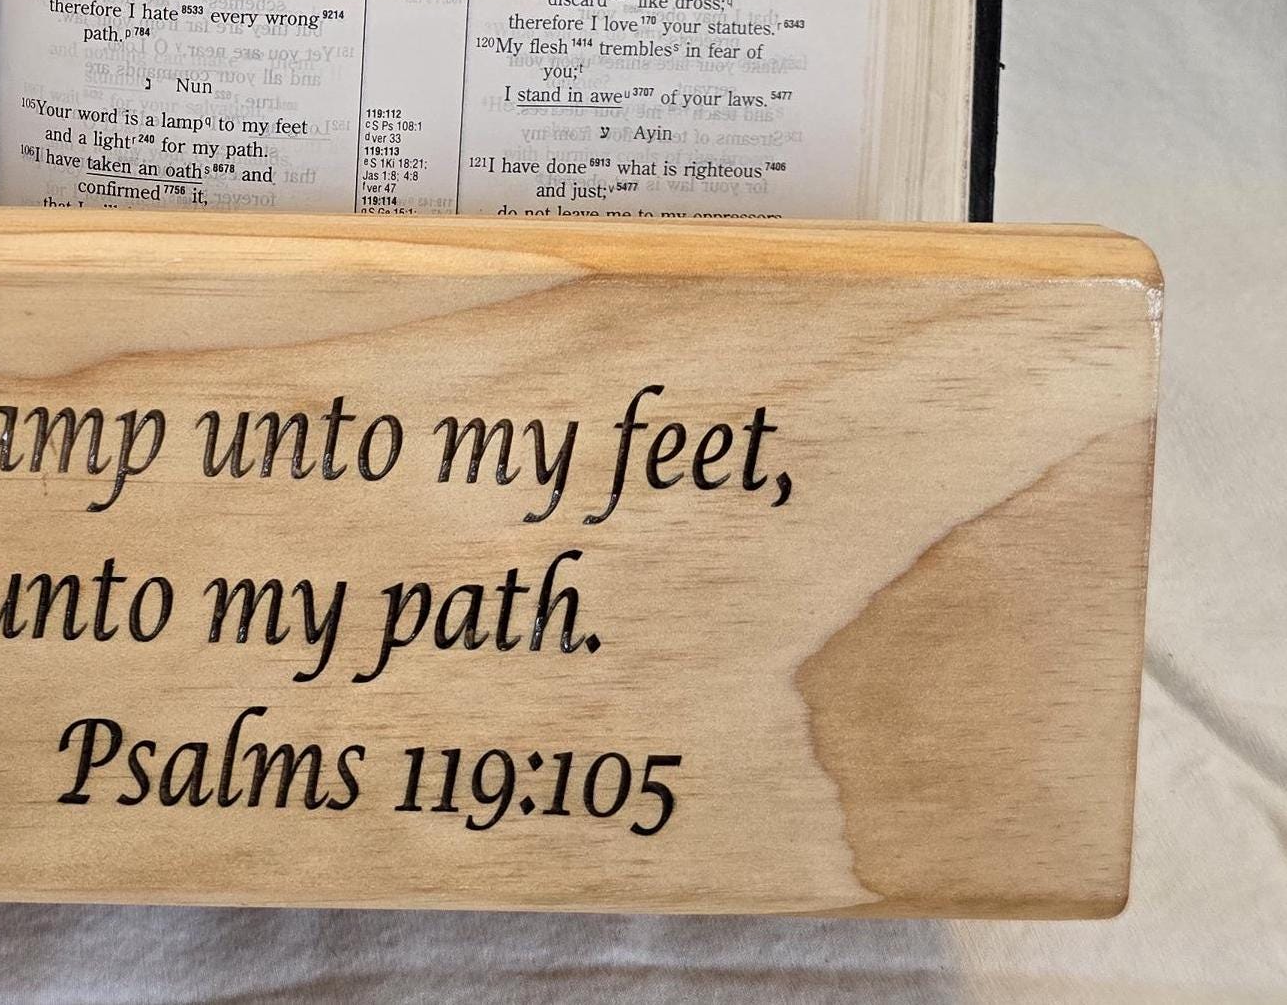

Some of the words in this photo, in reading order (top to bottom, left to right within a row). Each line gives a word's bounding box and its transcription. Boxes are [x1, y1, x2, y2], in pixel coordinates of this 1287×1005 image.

[175, 77, 213, 94] Nun
[78, 108, 117, 124] word
[125, 109, 139, 125] is
[145, 114, 155, 127] a
[366, 109, 402, 119] 119:112
[218, 116, 235, 133] to
[241, 121, 270, 137] my
[274, 117, 309, 135] feet
[632, 125, 673, 144] Ayin
[159, 136, 187, 155] for
[191, 142, 221, 159] my
[225, 140, 268, 160] path.
[362, 196, 397, 206] 119:114
[196, 396, 403, 481] unto
[434, 417, 578, 523] my
[583, 385, 792, 524] feet,
[204, 578, 347, 682] my
[352, 550, 601, 683] path.
[57, 706, 365, 810] Psalms
[395, 747, 682, 836] 119:105
